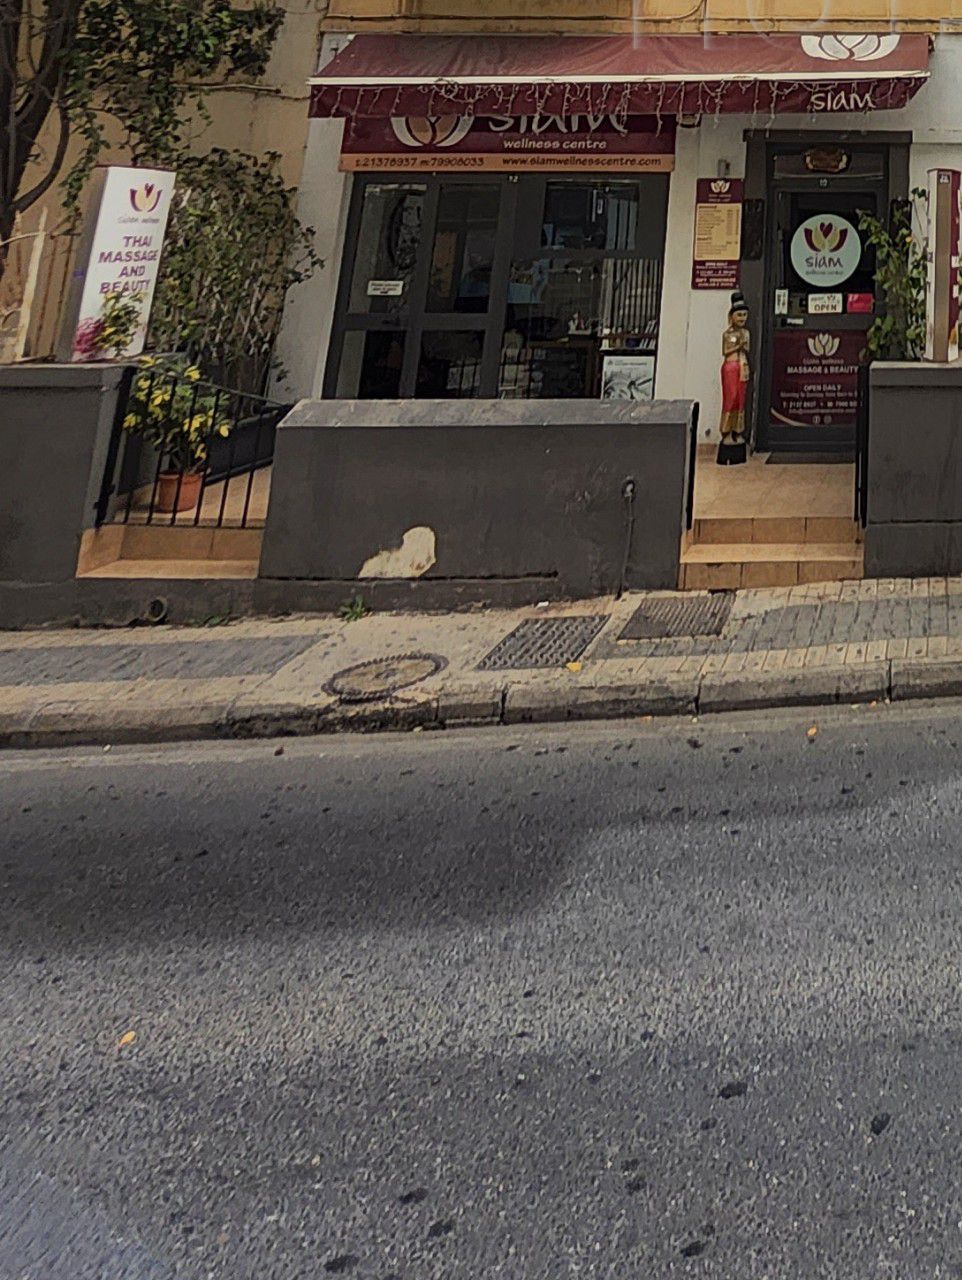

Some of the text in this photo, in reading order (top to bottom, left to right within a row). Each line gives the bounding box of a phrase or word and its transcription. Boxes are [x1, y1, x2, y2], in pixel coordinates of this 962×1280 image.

[810, 91, 876, 110] siam
[503, 138, 607, 149] wellness centre
[122, 235, 152, 247] THAI
[98, 249, 159, 263] MASSAGE
[804, 253, 844, 269] siam
[118, 265, 146, 278] AND
[814, 304, 837, 312] OPEN
[787, 366, 822, 374] MASSAGE
[830, 366, 859, 374] BEAUTY
